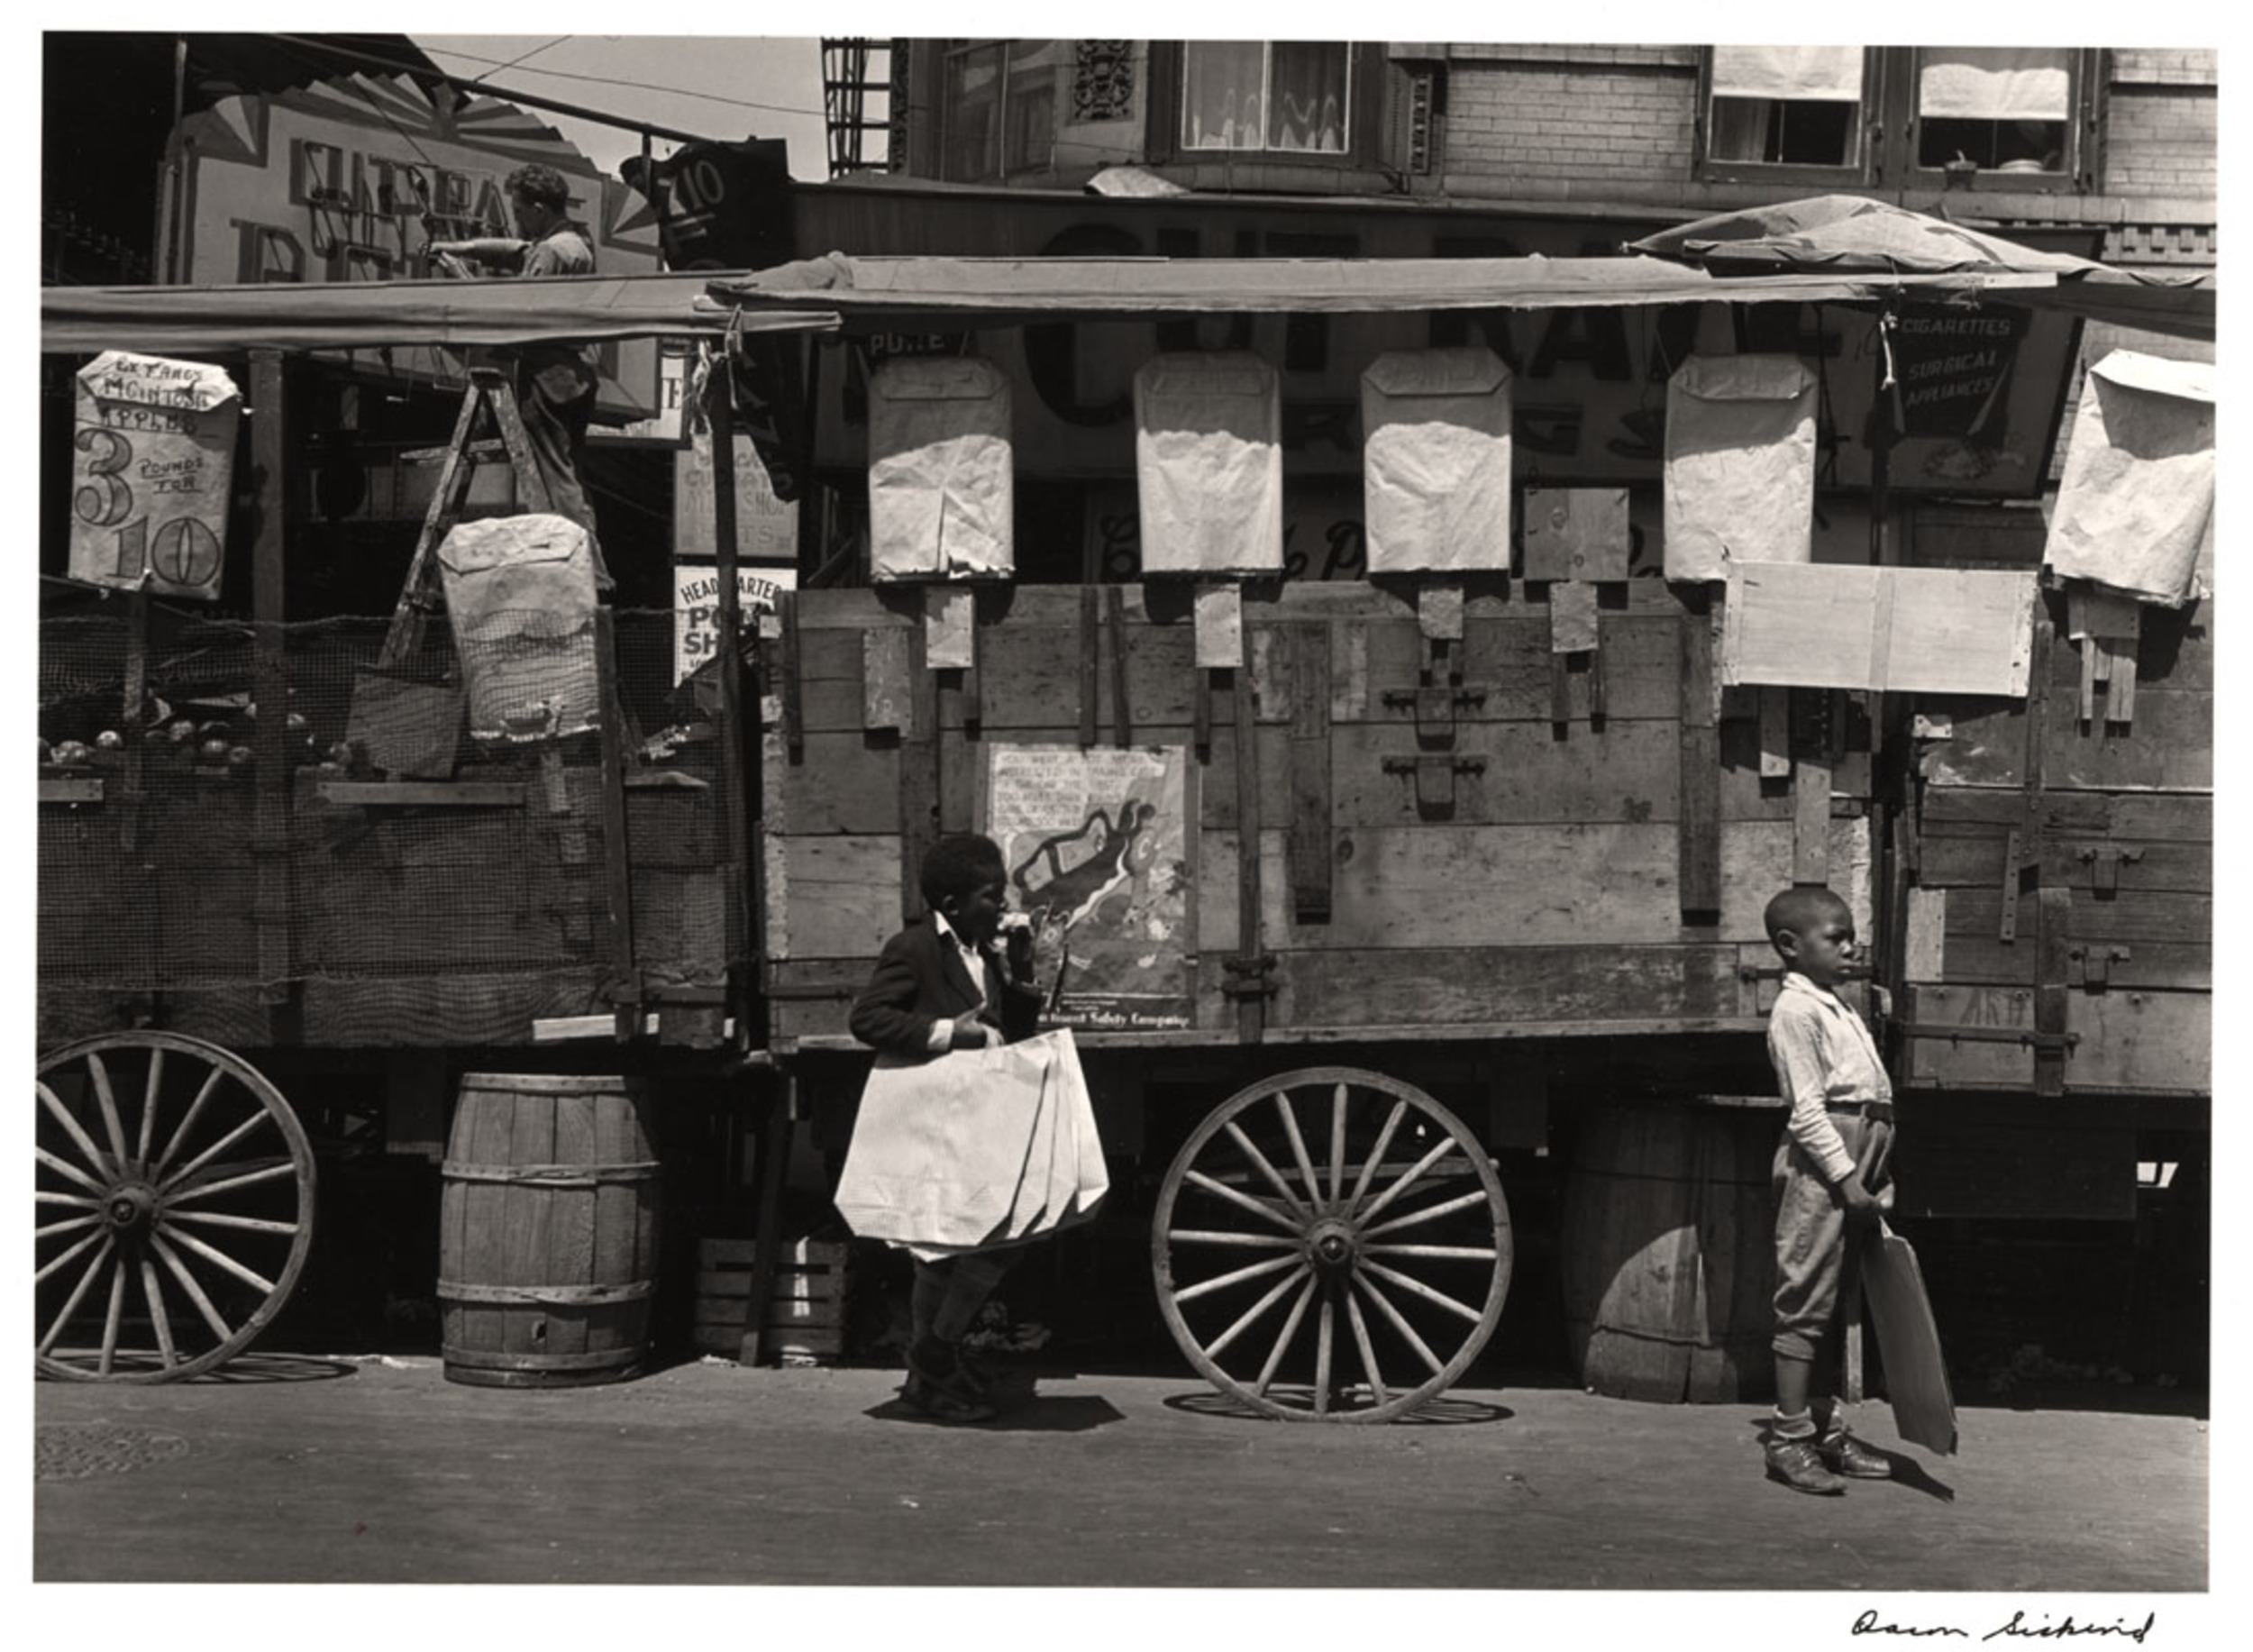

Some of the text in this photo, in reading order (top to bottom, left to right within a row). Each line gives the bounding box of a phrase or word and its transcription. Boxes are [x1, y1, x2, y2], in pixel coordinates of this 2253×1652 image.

[1902, 317, 2011, 335] CIGARETTES
[75, 427, 132, 527] 3
[106, 516, 221, 586] 10
